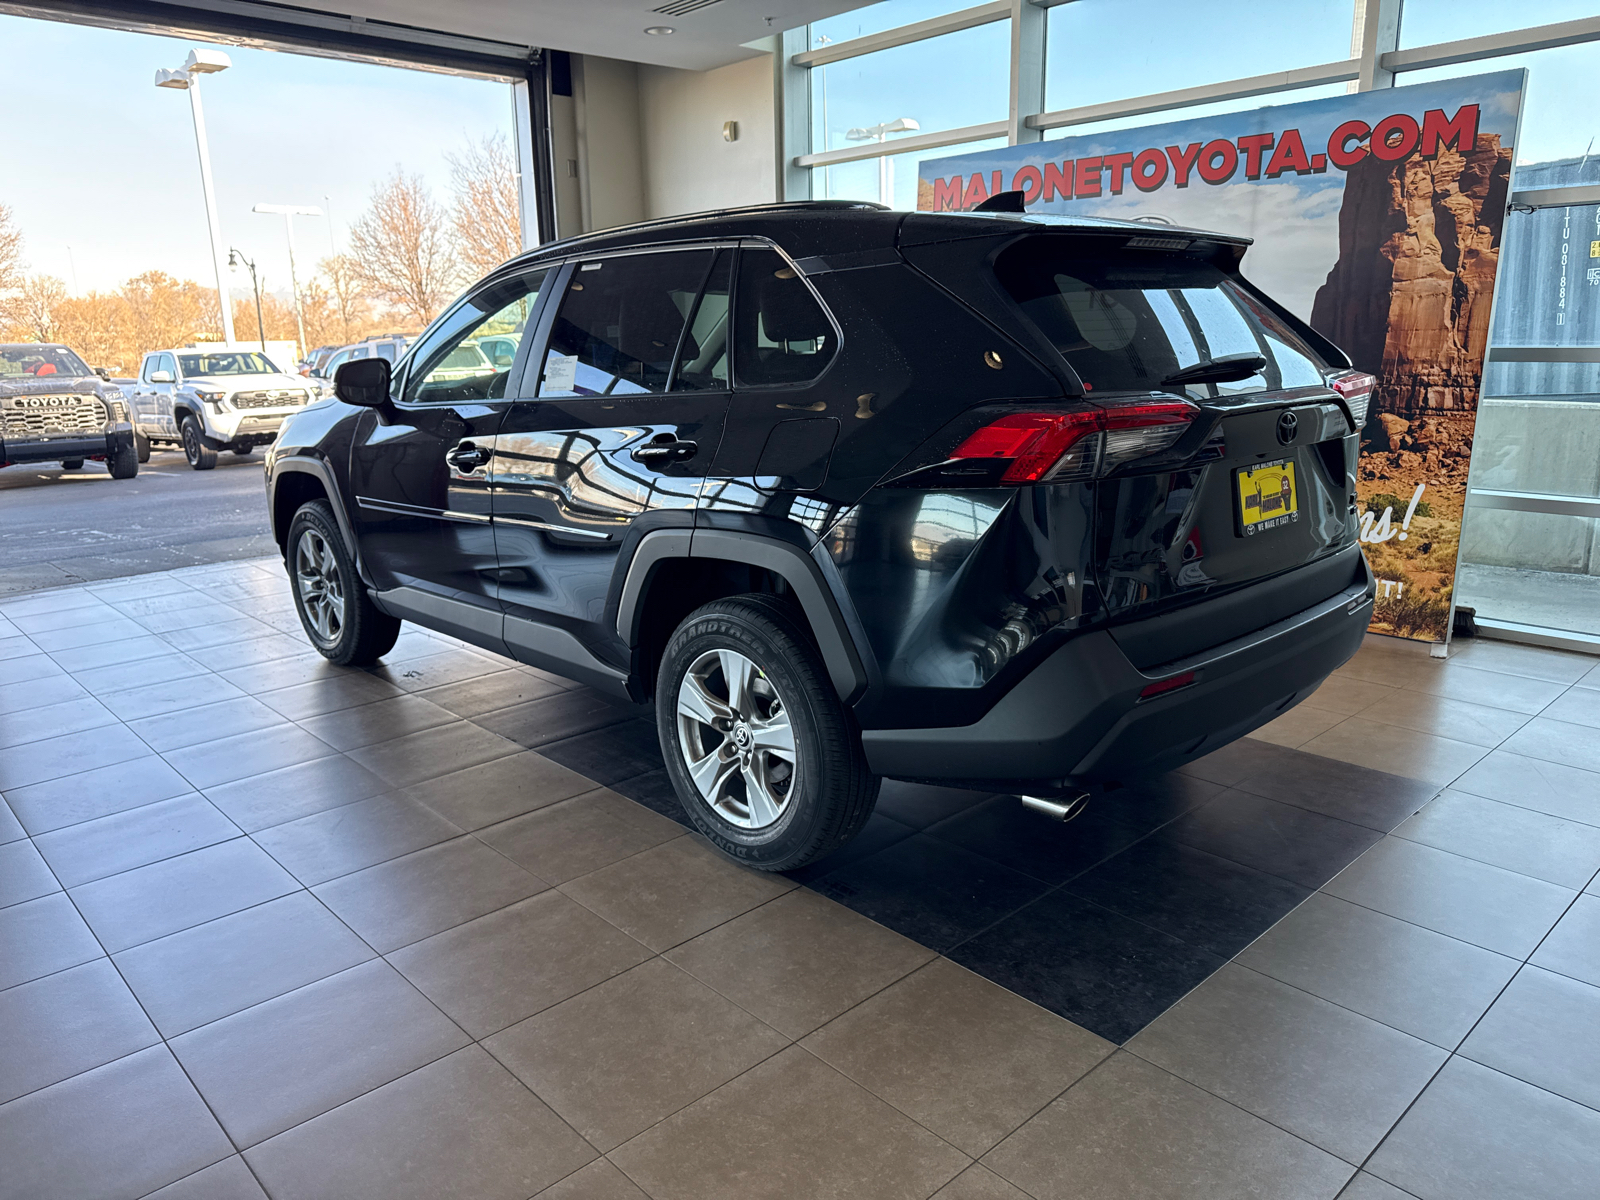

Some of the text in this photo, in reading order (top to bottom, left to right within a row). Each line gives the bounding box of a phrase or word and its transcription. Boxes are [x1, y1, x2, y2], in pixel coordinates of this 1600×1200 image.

[21, 397, 77, 408] TOYOTA
[1257, 523, 1264, 532] WE
[1264, 519, 1276, 530] MAKE
[1279, 515, 1289, 525] EASY
[671, 621, 768, 658] GRANDTREK
